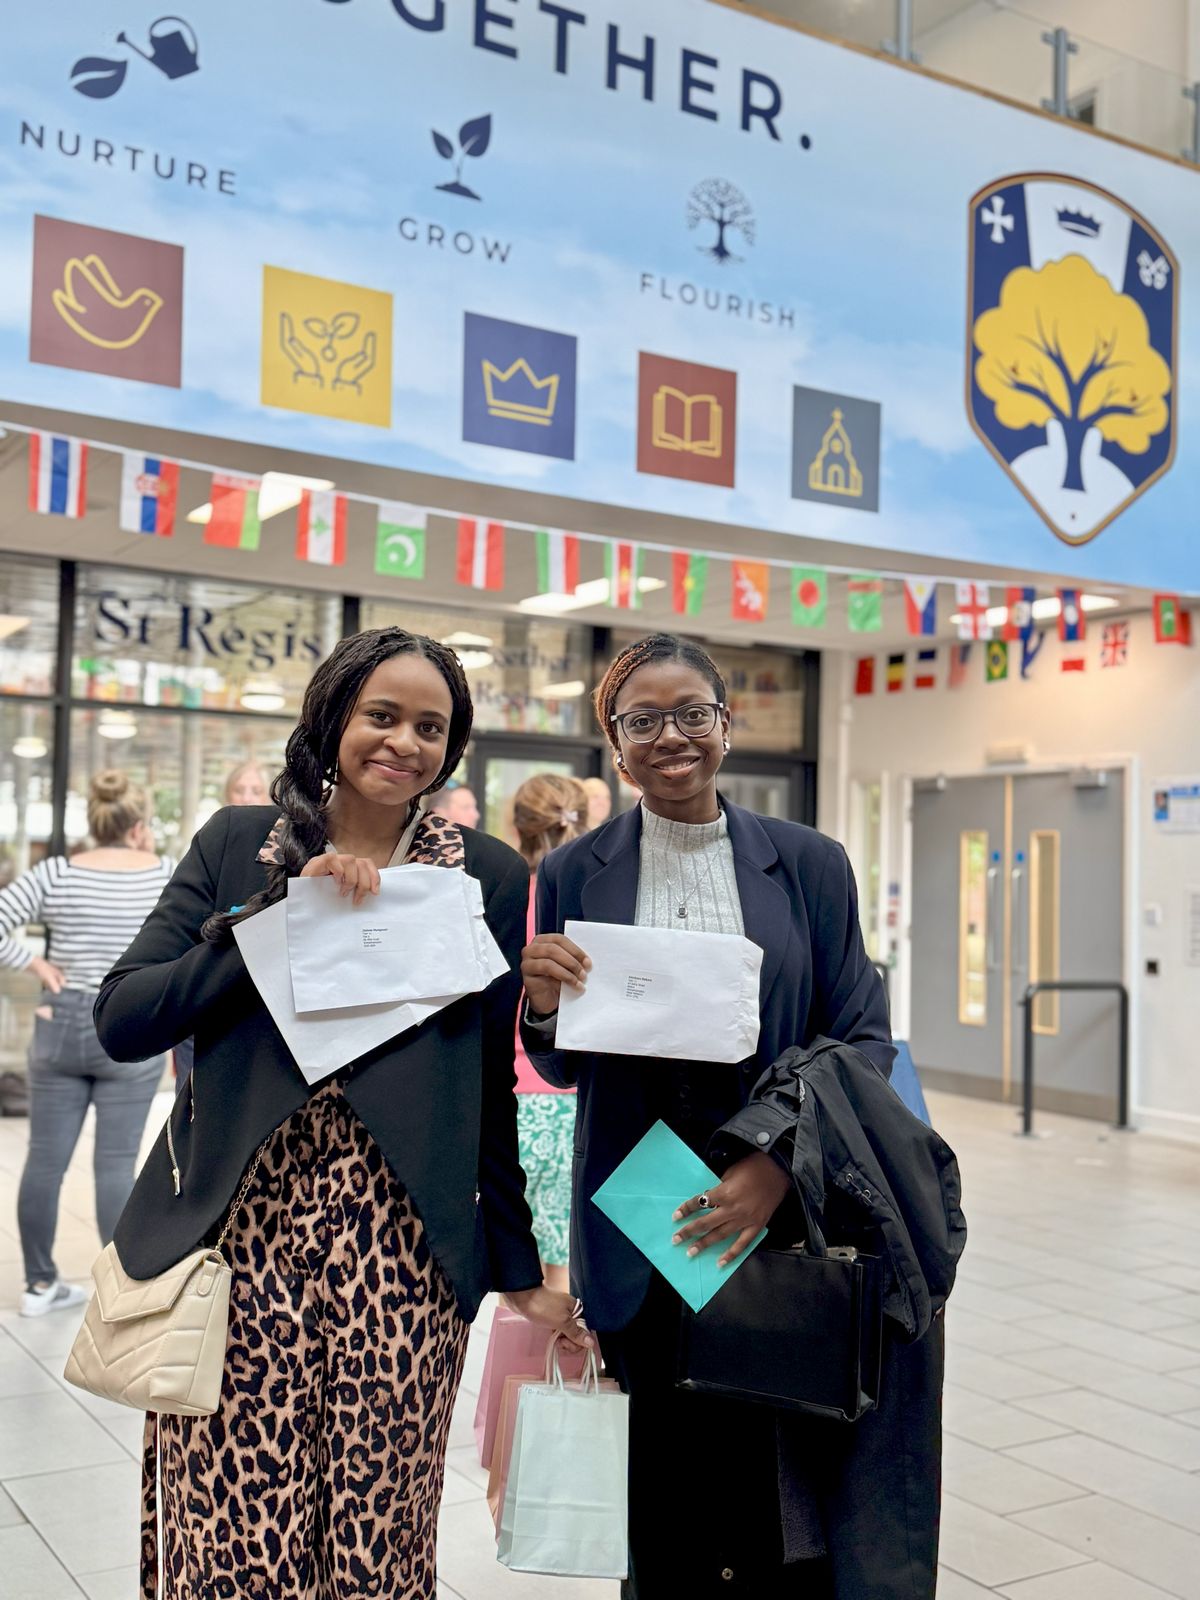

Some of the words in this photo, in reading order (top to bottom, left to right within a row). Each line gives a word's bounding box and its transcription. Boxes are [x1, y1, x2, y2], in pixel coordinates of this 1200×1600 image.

[20, 120, 237, 196] NURTURE
[399, 217, 512, 264] GROW
[640, 273, 796, 328] FLOURISH
[179, 603, 321, 672] Regis
